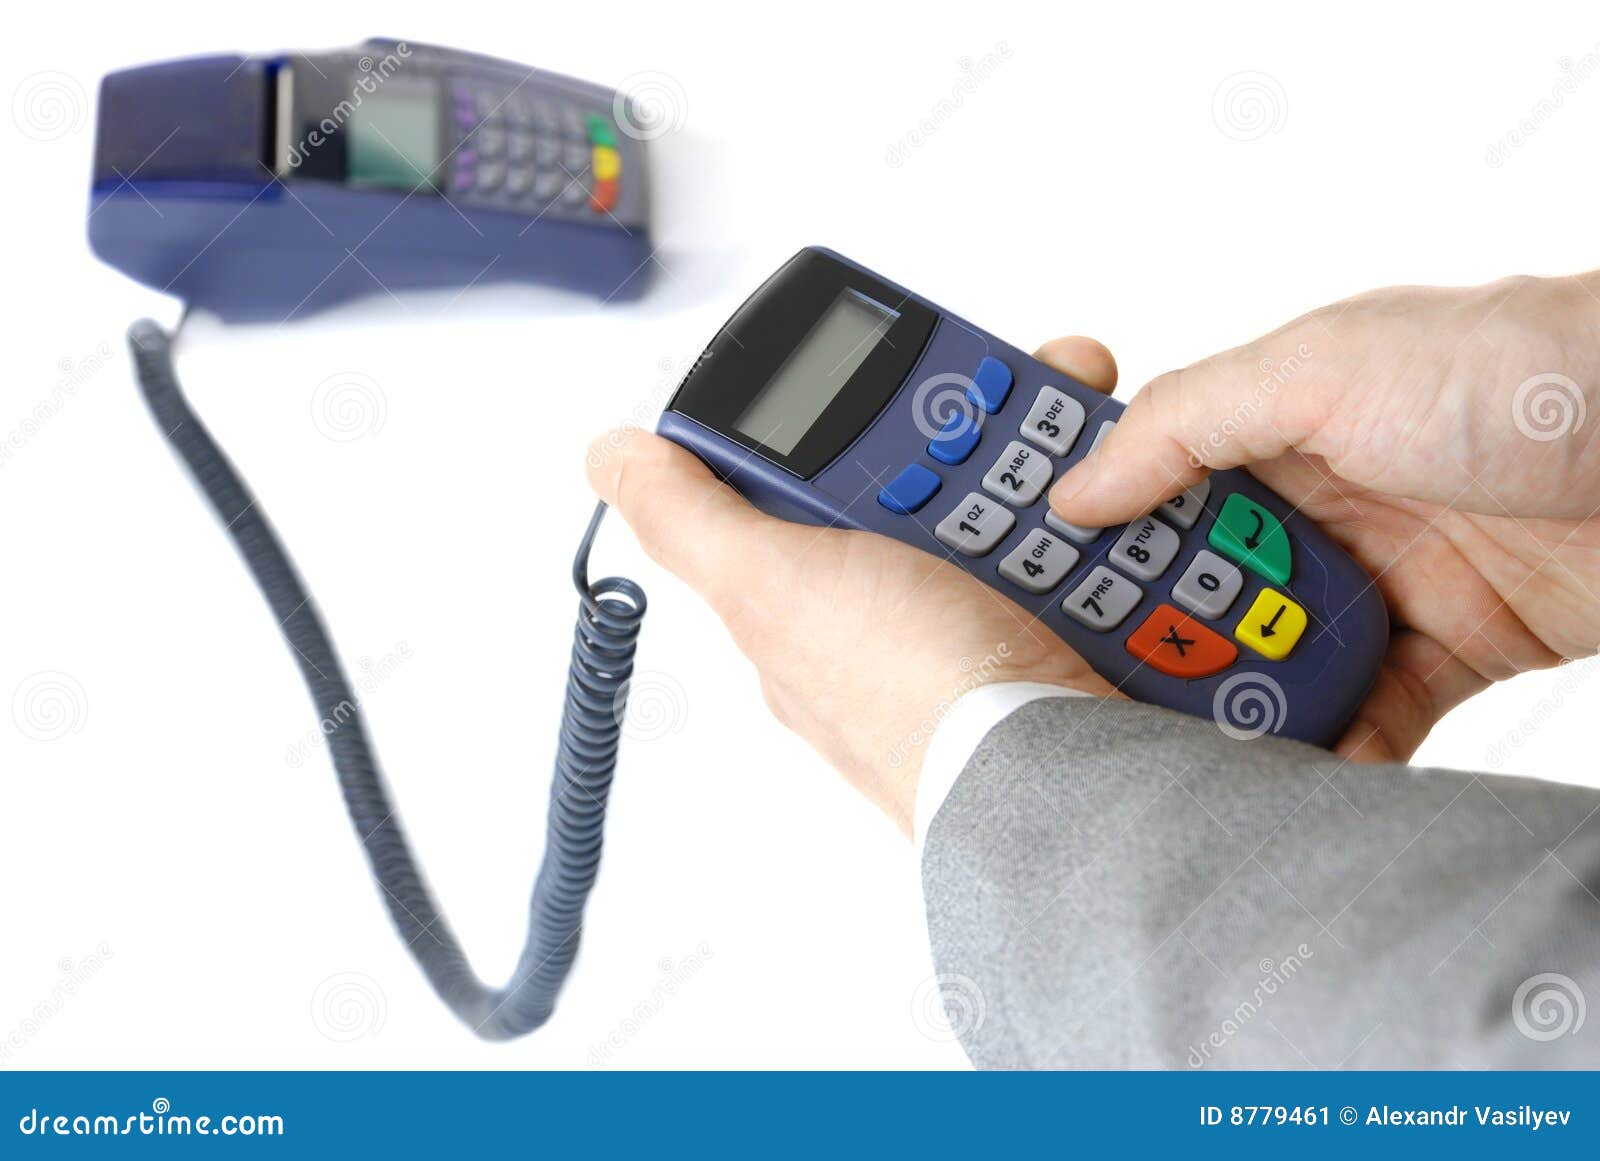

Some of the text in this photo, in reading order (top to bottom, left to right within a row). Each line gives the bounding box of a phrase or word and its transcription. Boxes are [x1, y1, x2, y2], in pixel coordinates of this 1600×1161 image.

[1045, 398, 1065, 420] DEF
[1012, 449, 1030, 474] ABC
[1134, 521, 1156, 545] TUV
[1032, 537, 1052, 559] GHI
[1091, 576, 1114, 600] PRS
